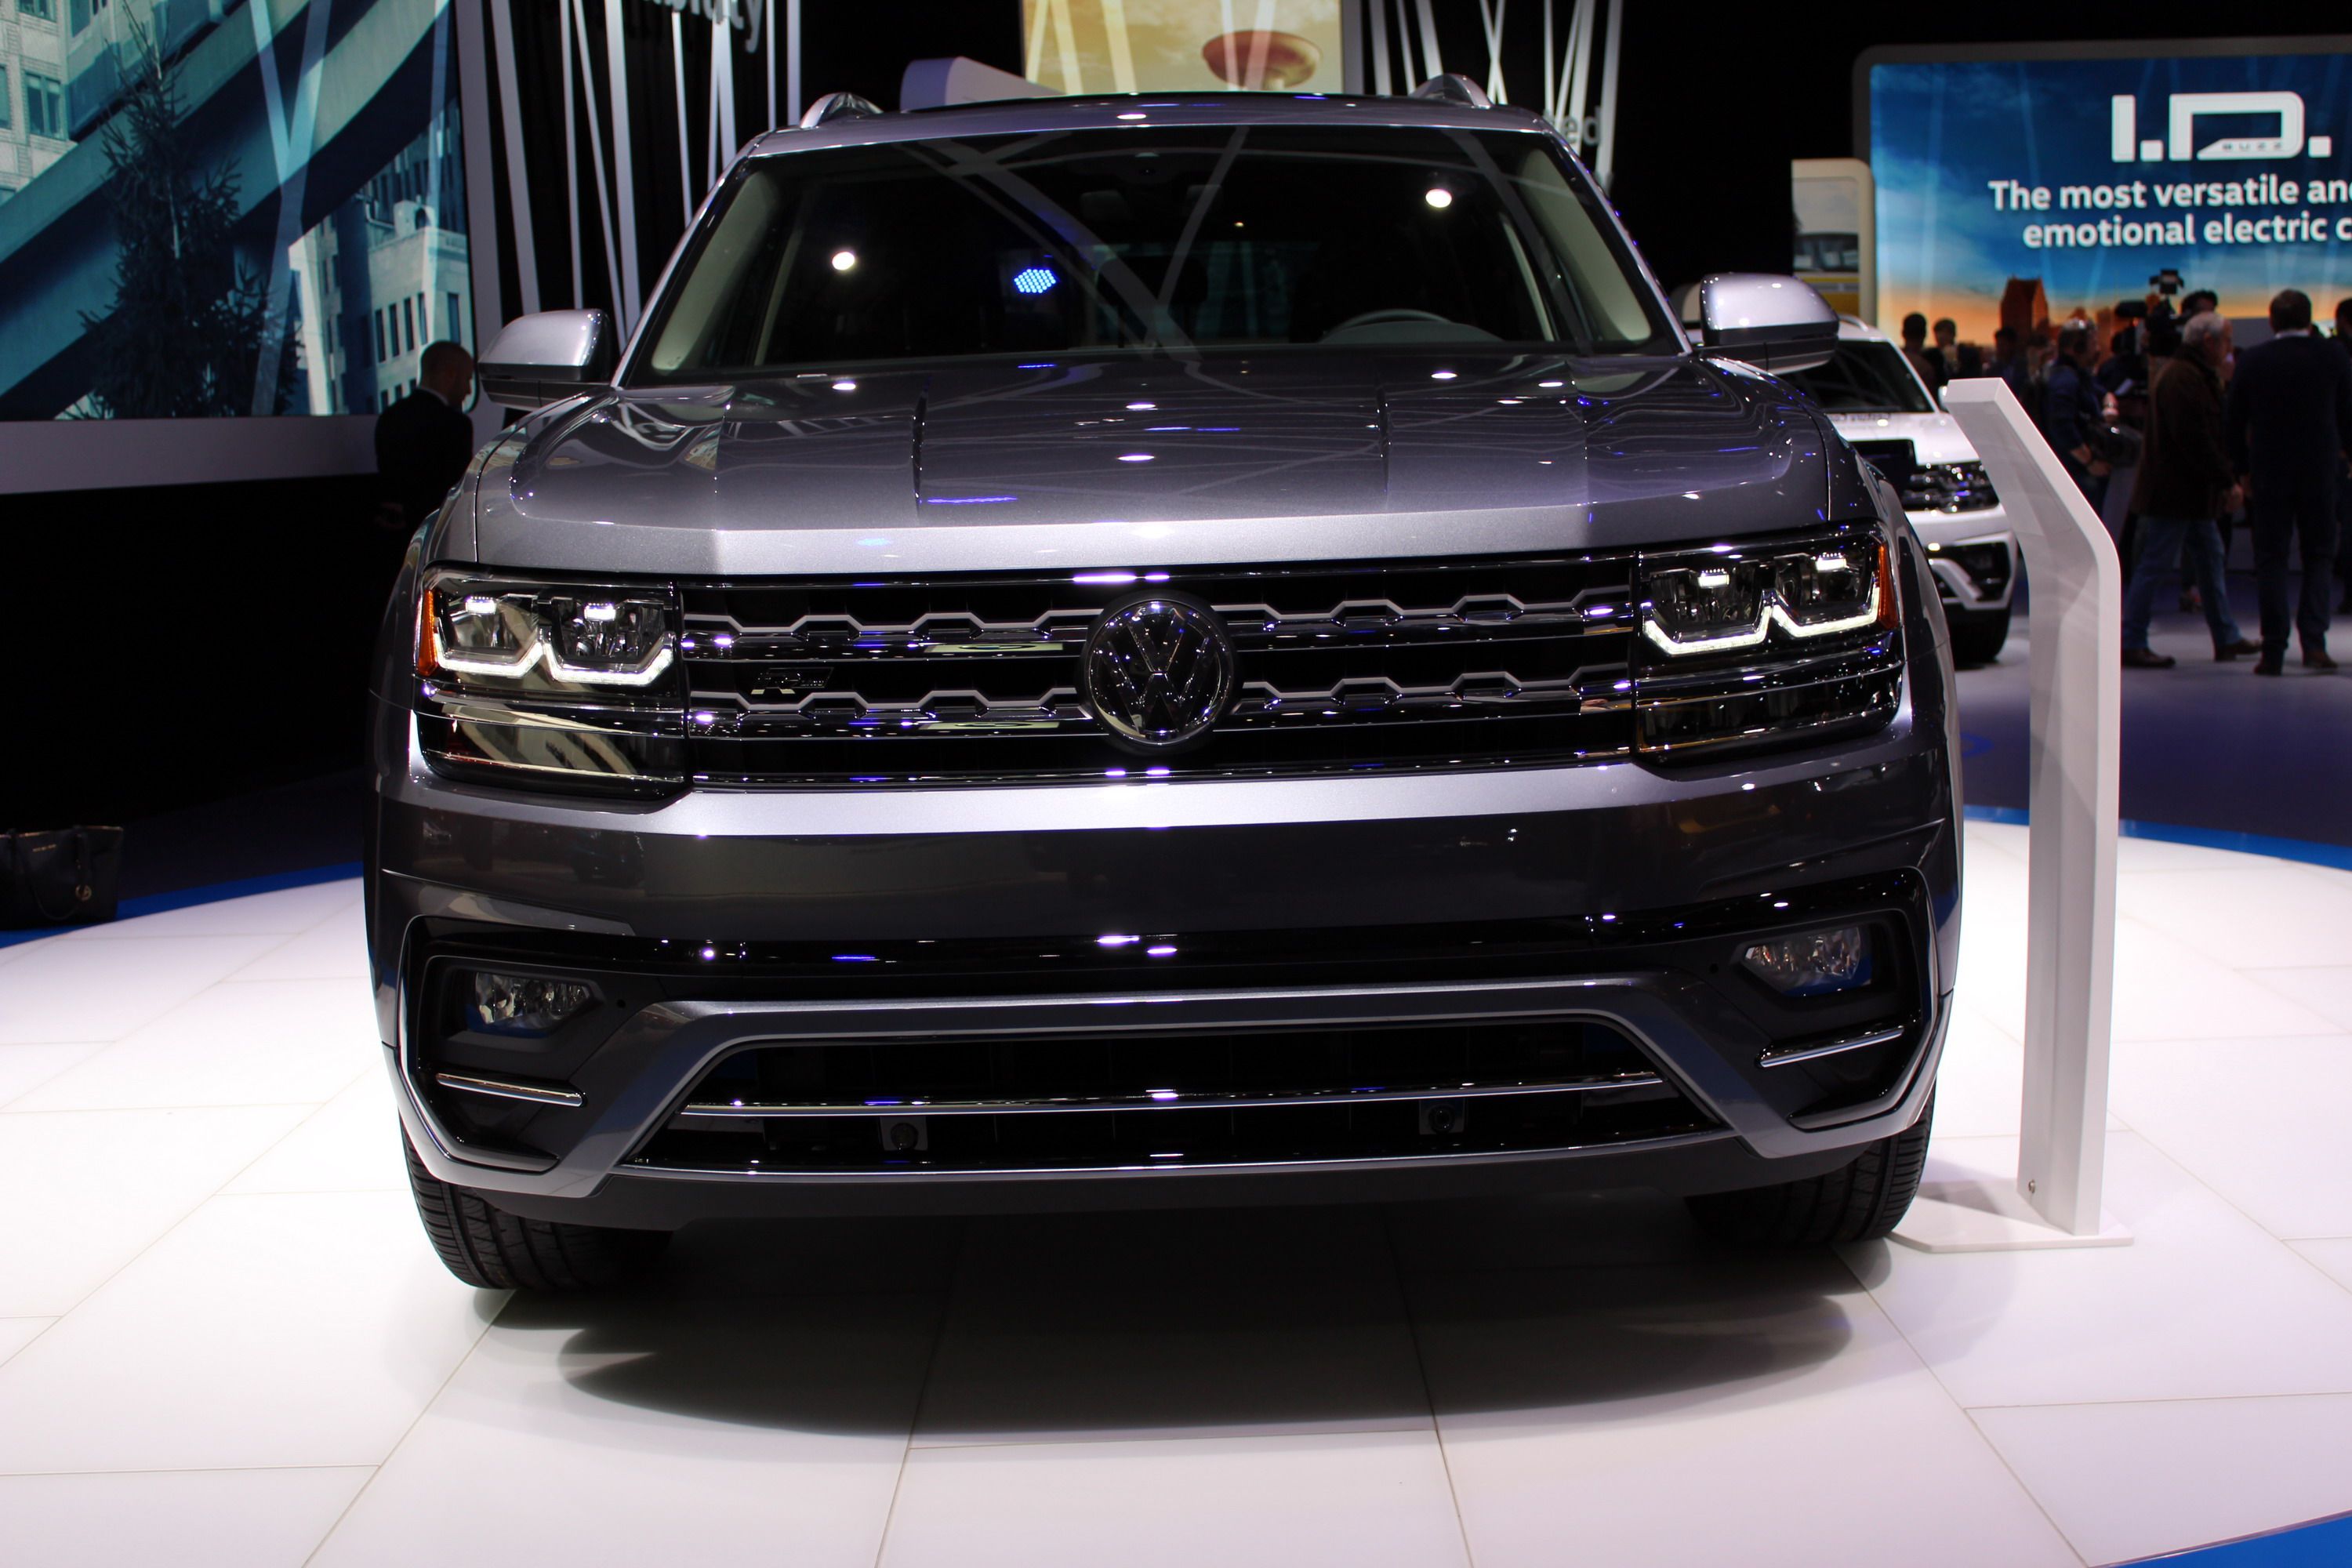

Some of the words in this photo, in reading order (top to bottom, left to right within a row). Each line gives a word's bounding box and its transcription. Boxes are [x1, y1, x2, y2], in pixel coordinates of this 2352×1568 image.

[1988, 180, 2051, 211] The
[2060, 181, 2147, 209] most
[2154, 173, 2300, 207] versatile
[2307, 180, 2352, 205] an
[2023, 213, 2196, 249] emotional
[2203, 210, 2328, 244] electric
